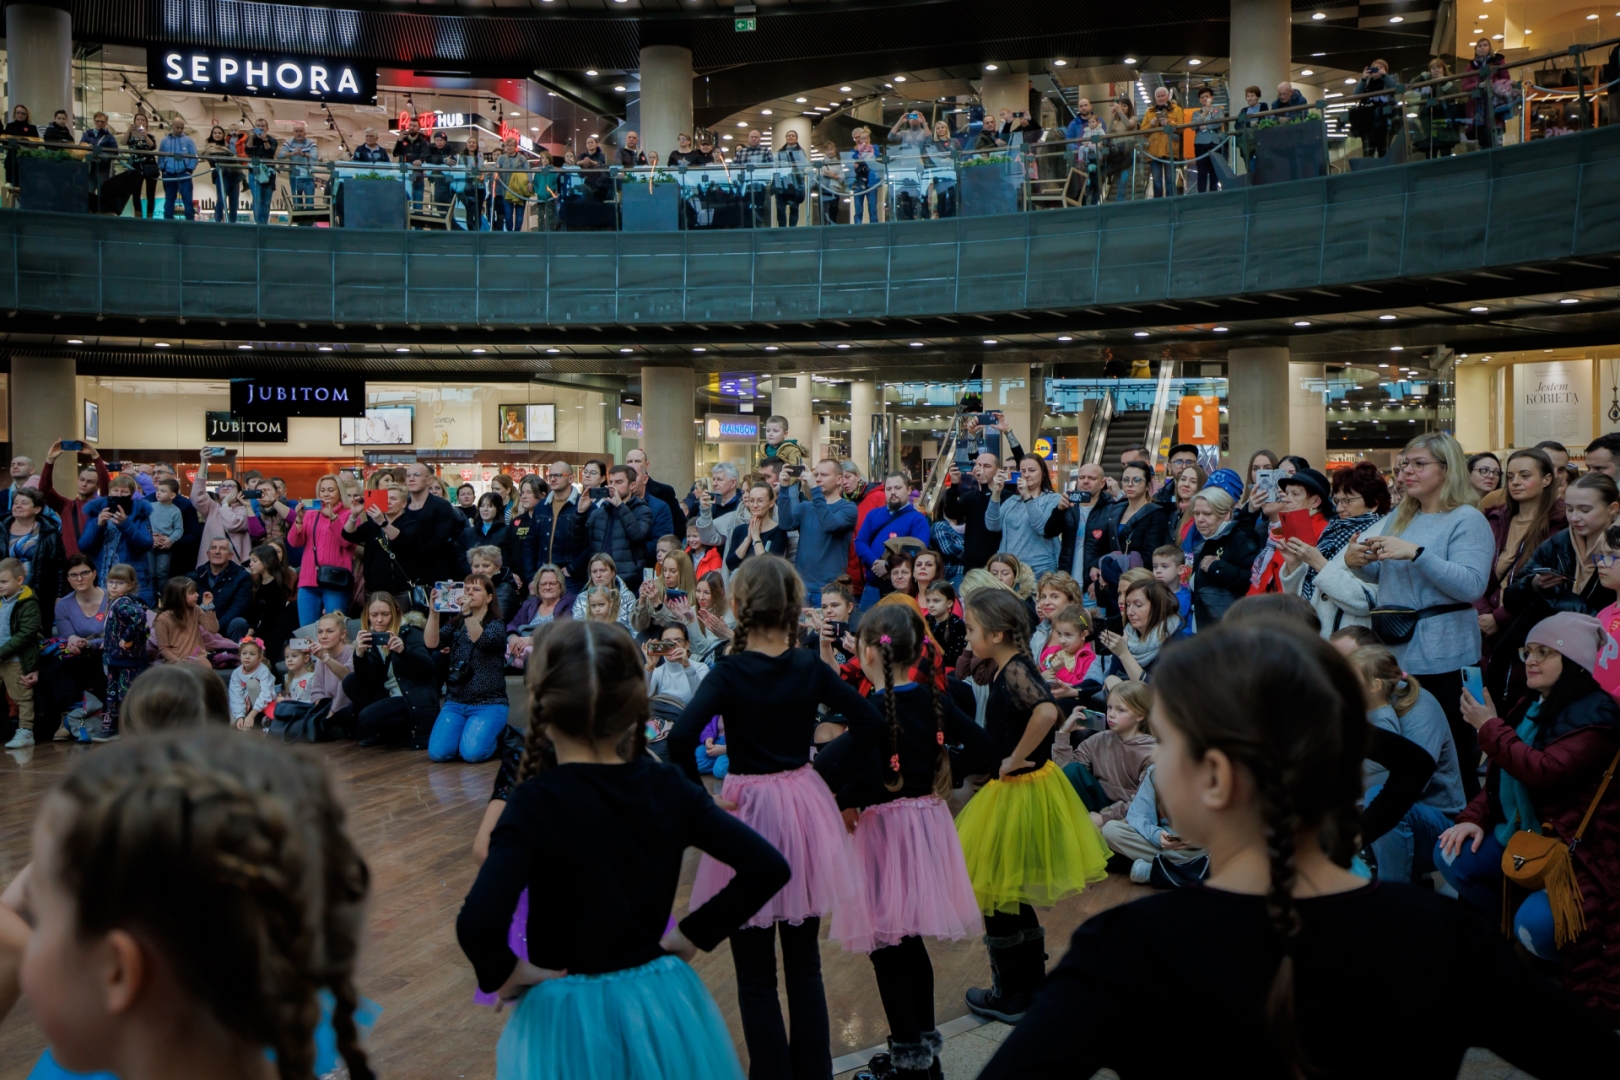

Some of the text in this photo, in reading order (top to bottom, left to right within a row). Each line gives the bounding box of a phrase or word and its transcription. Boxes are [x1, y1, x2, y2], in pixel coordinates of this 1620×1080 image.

[165, 53, 360, 94] SEPHORA
[437, 113, 464, 127] HUB
[1535, 381, 1569, 392] Jestem
[247, 384, 350, 404] JUBITOM
[1526, 393, 1579, 405] KOBIETĄ
[211, 420, 282, 435] JUBITOM
[721, 423, 757, 435] RAINBOW
